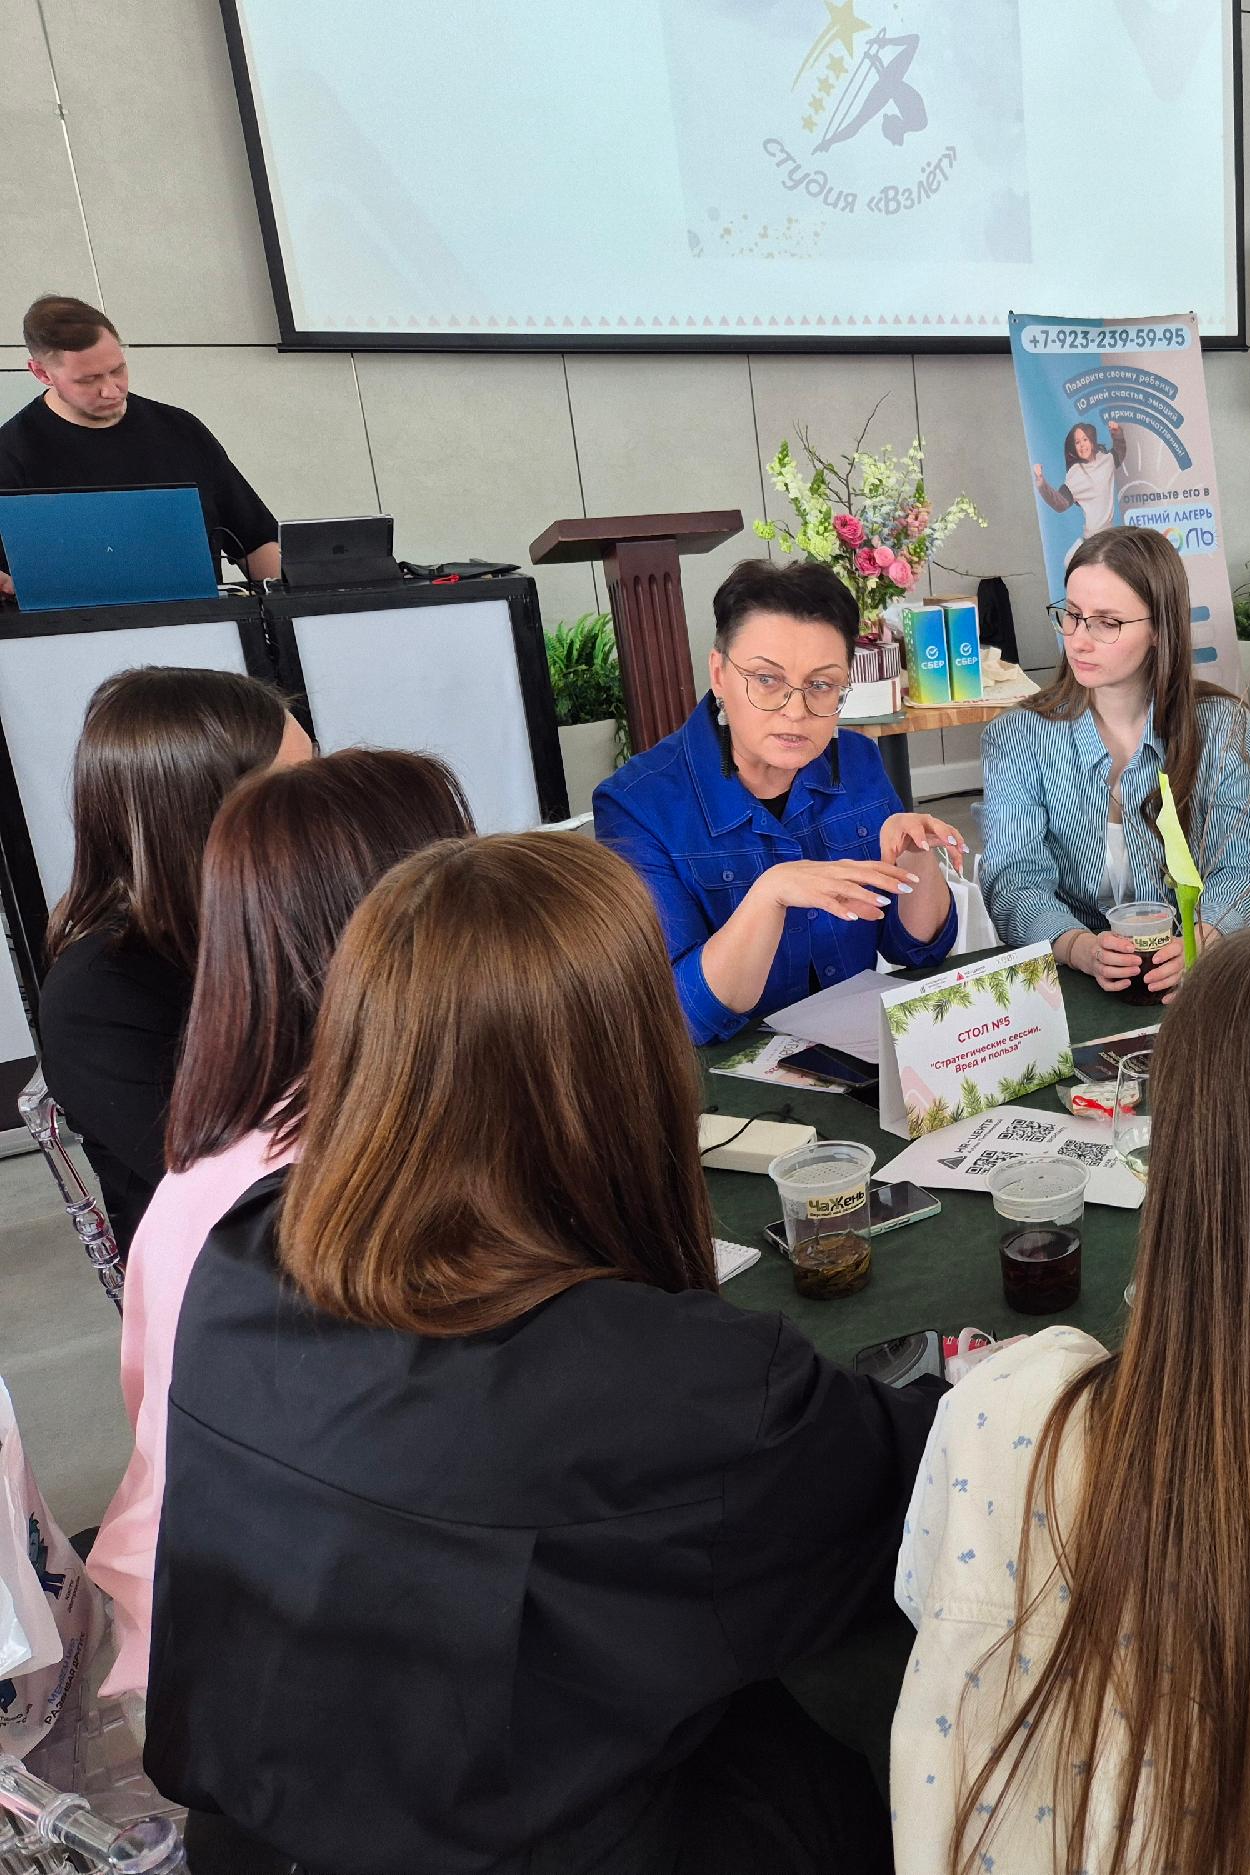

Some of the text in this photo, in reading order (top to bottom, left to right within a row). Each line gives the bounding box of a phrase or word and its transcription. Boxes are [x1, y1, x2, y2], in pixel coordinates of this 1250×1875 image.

[1029, 328, 1185, 349] +7-923-239-59-95
[1065, 371, 1104, 393] Подарите
[1107, 371, 1137, 382] своему
[1089, 389, 1109, 404] дней
[1123, 487, 1210, 505] отправьте его в
[1128, 508, 1213, 526] ЛЕТНИЙ ЛАГЕРЬ
[921, 661, 944, 669] СБЕР
[955, 657, 978, 666] СБЕР
[957, 1016, 1011, 1043] СТОЛ №5
[930, 1026, 1041, 1070] "Стратегические сессии.
[955, 1059, 979, 1073] Вред
[988, 1042, 1022, 1060] польза"
